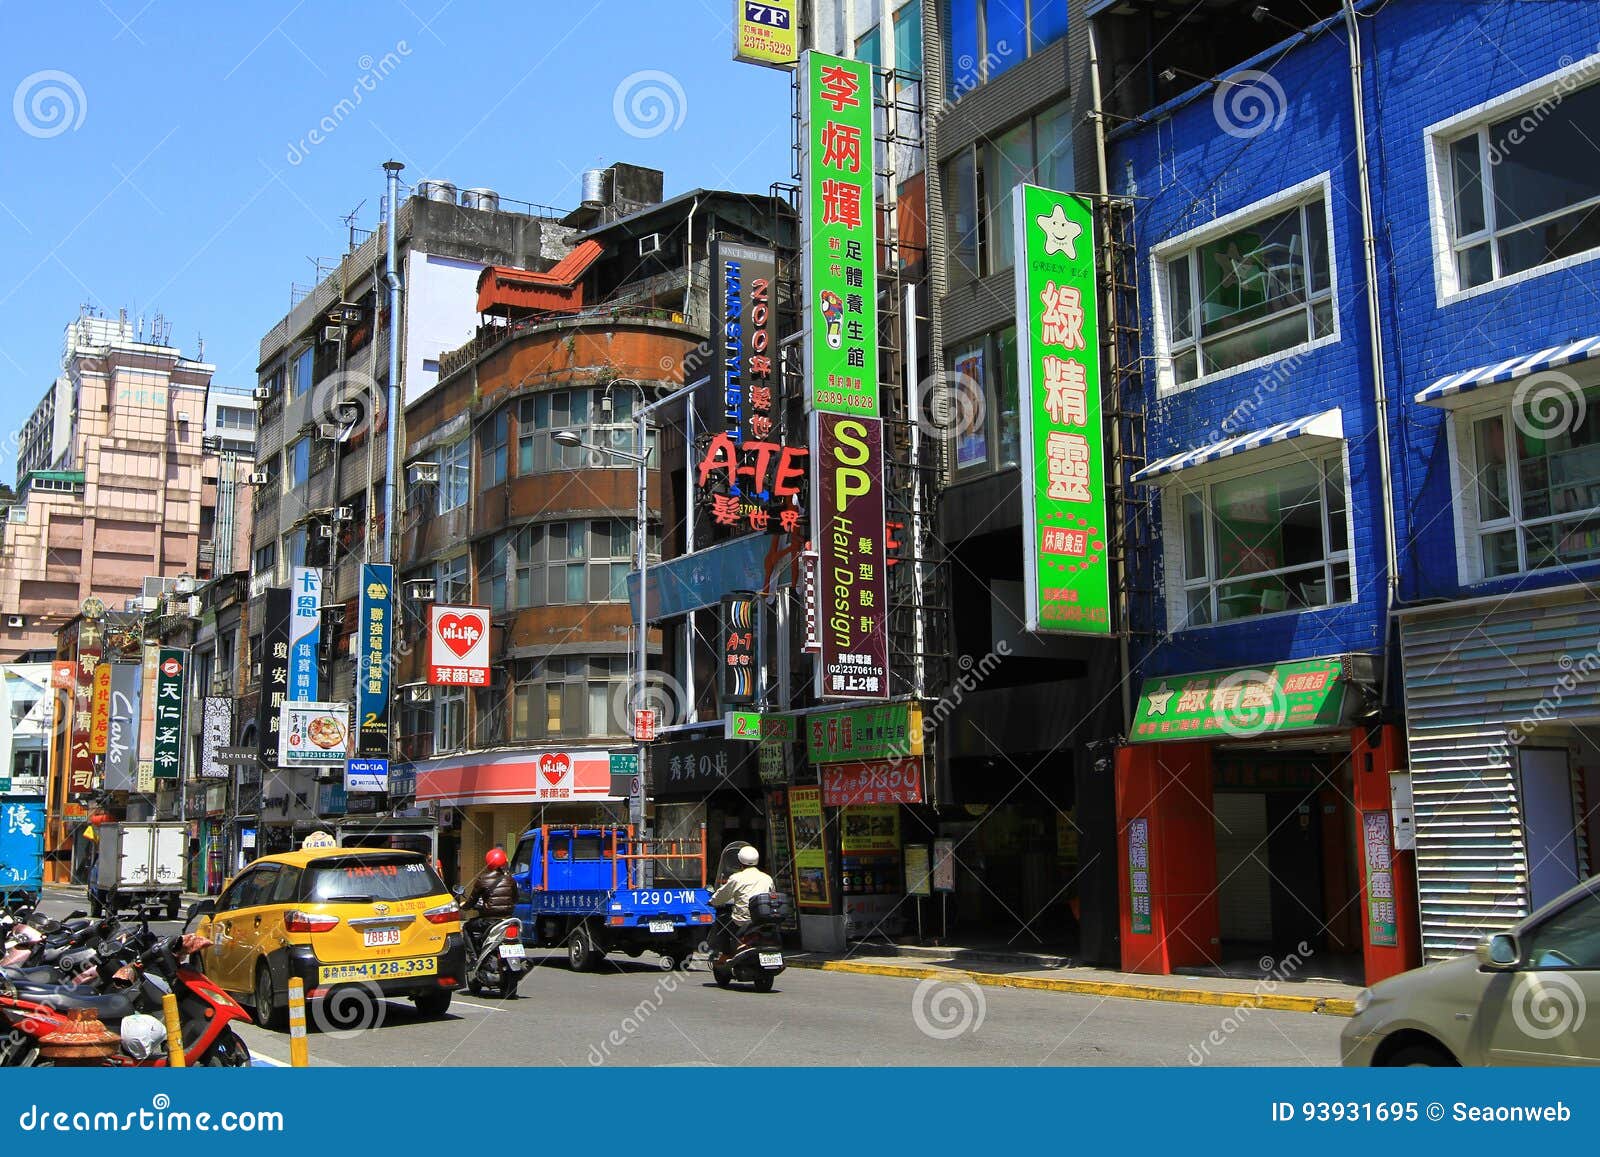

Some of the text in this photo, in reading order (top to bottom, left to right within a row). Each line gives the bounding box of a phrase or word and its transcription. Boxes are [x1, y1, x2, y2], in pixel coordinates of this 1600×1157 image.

[748, 4, 787, 26] 7F
[743, 35, 792, 56] 2375-5229
[820, 65, 863, 231] 李炳輝
[829, 237, 841, 278] 新一代
[725, 261, 742, 319] HAIR
[845, 240, 865, 369] 足體養生館
[725, 320, 742, 423] STYLIST
[816, 390, 873, 409] 2389-0828
[1040, 280, 1092, 504] 綠精靈
[698, 432, 809, 497] A-TE
[833, 420, 871, 513] SP
[712, 494, 801, 533] 髮世界
[1044, 530, 1084, 554] 休閒食品
[296, 571, 318, 618] 卡恩
[830, 515, 854, 648] Hair Design
[858, 537, 874, 633] 髮型設計
[368, 607, 384, 694] 聯強電信聯盟
[443, 622, 479, 646] Hi-Life
[436, 667, 485, 684] 萊爾富
[827, 663, 883, 676] (02)23706116
[832, 675, 879, 692] 請上2樓
[94, 672, 111, 748] 台北天后宮
[110, 690, 134, 764] Clarks
[155, 683, 181, 768] 天仁茗茶
[351, 763, 384, 771] NOKIA
[542, 760, 568, 777] Hi-Life
[670, 751, 728, 780] 秀秀の店
[539, 788, 570, 799] 萊爾富
[406, 864, 425, 872] 3610
[1367, 815, 1392, 898] 綠精靈
[631, 890, 695, 904] 1290-YM
[366, 929, 399, 943] 788-A9
[358, 958, 434, 976] 4128-333
